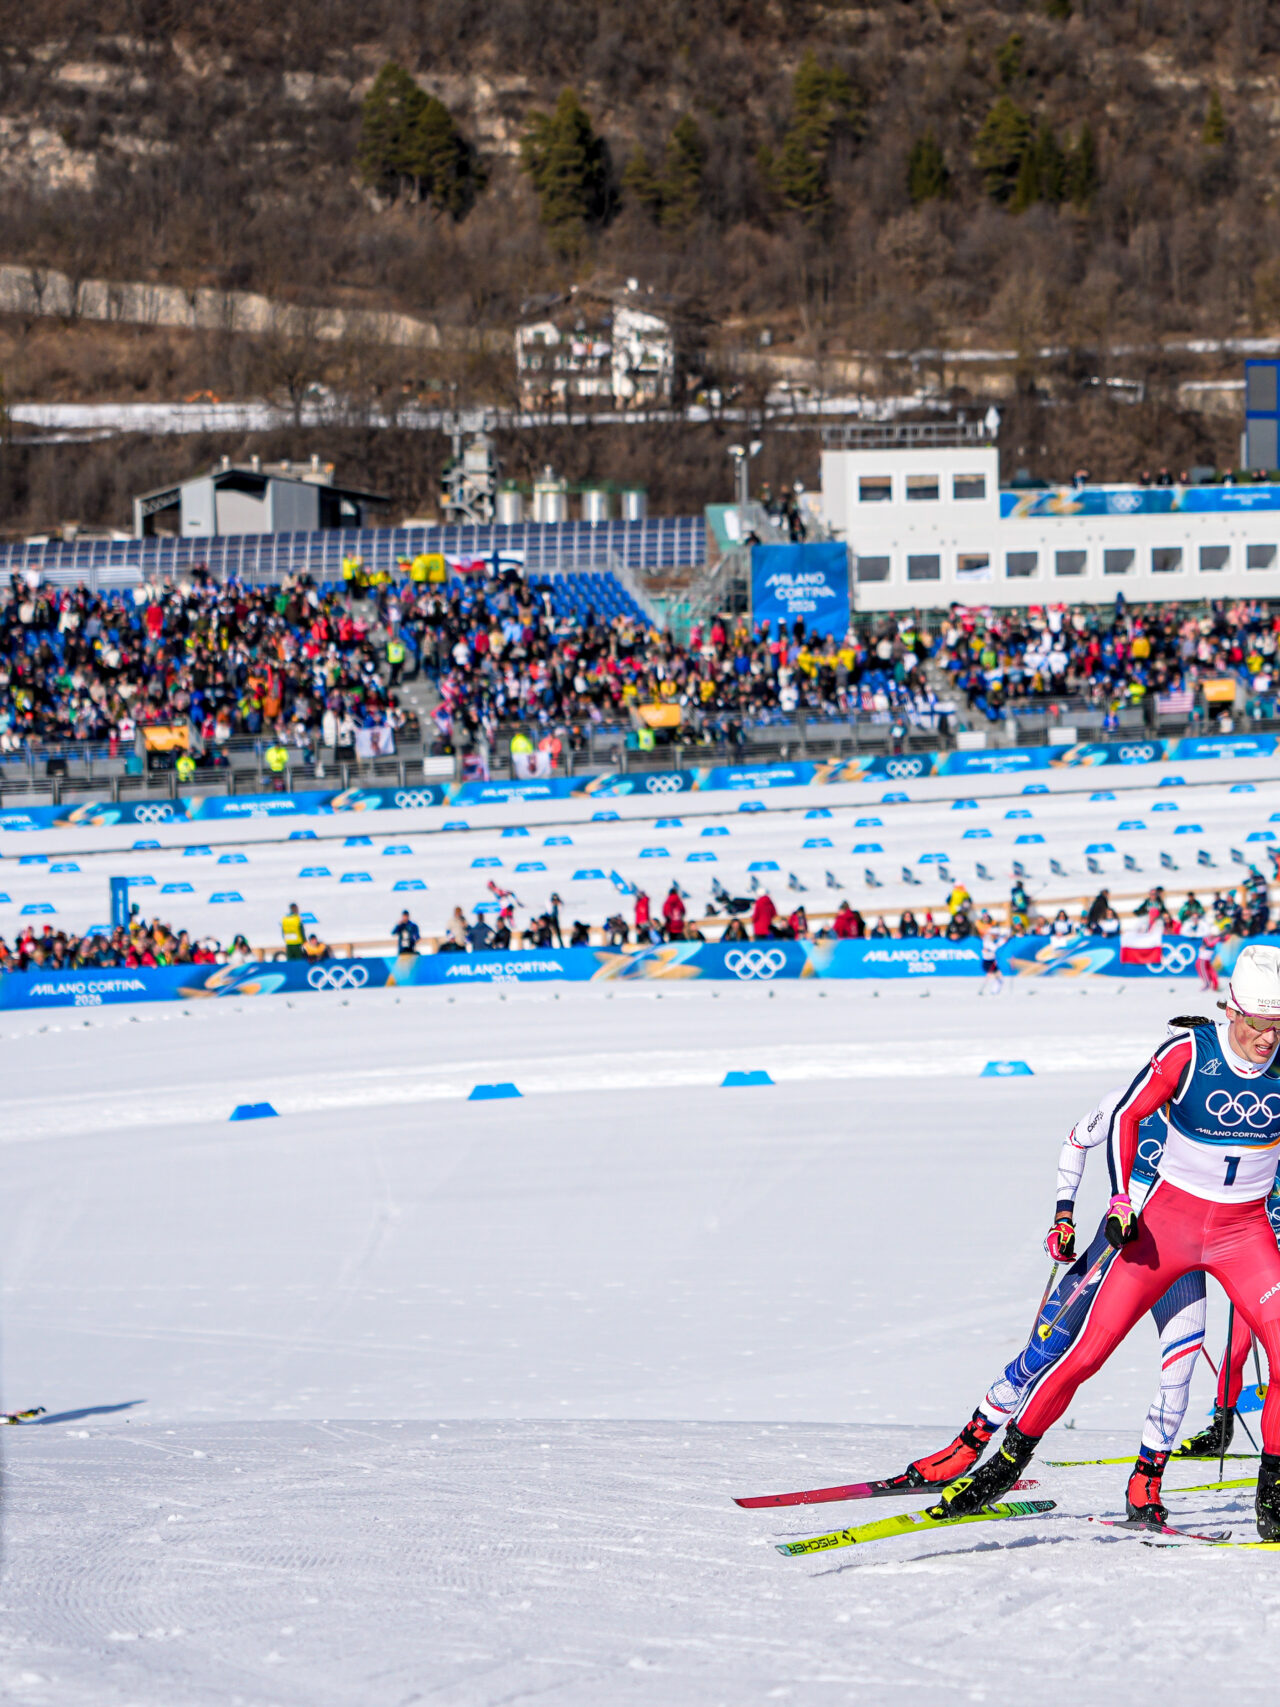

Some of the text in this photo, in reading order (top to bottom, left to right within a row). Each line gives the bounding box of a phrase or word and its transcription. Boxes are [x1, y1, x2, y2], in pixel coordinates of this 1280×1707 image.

[765, 571, 825, 587] MILANO
[775, 586, 836, 600] CORTINA
[862, 949, 980, 962] MILANO CORTINA
[446, 961, 563, 976] MILANO CORTINA
[29, 979, 146, 996] MILANO CORTINA
[75, 994, 103, 1006] 2026
[1195, 1128, 1231, 1137] MILANO
[1232, 1131, 1268, 1139] CORTINA
[1223, 1156, 1241, 1186] 1
[789, 1535, 839, 1554] FISCHER
